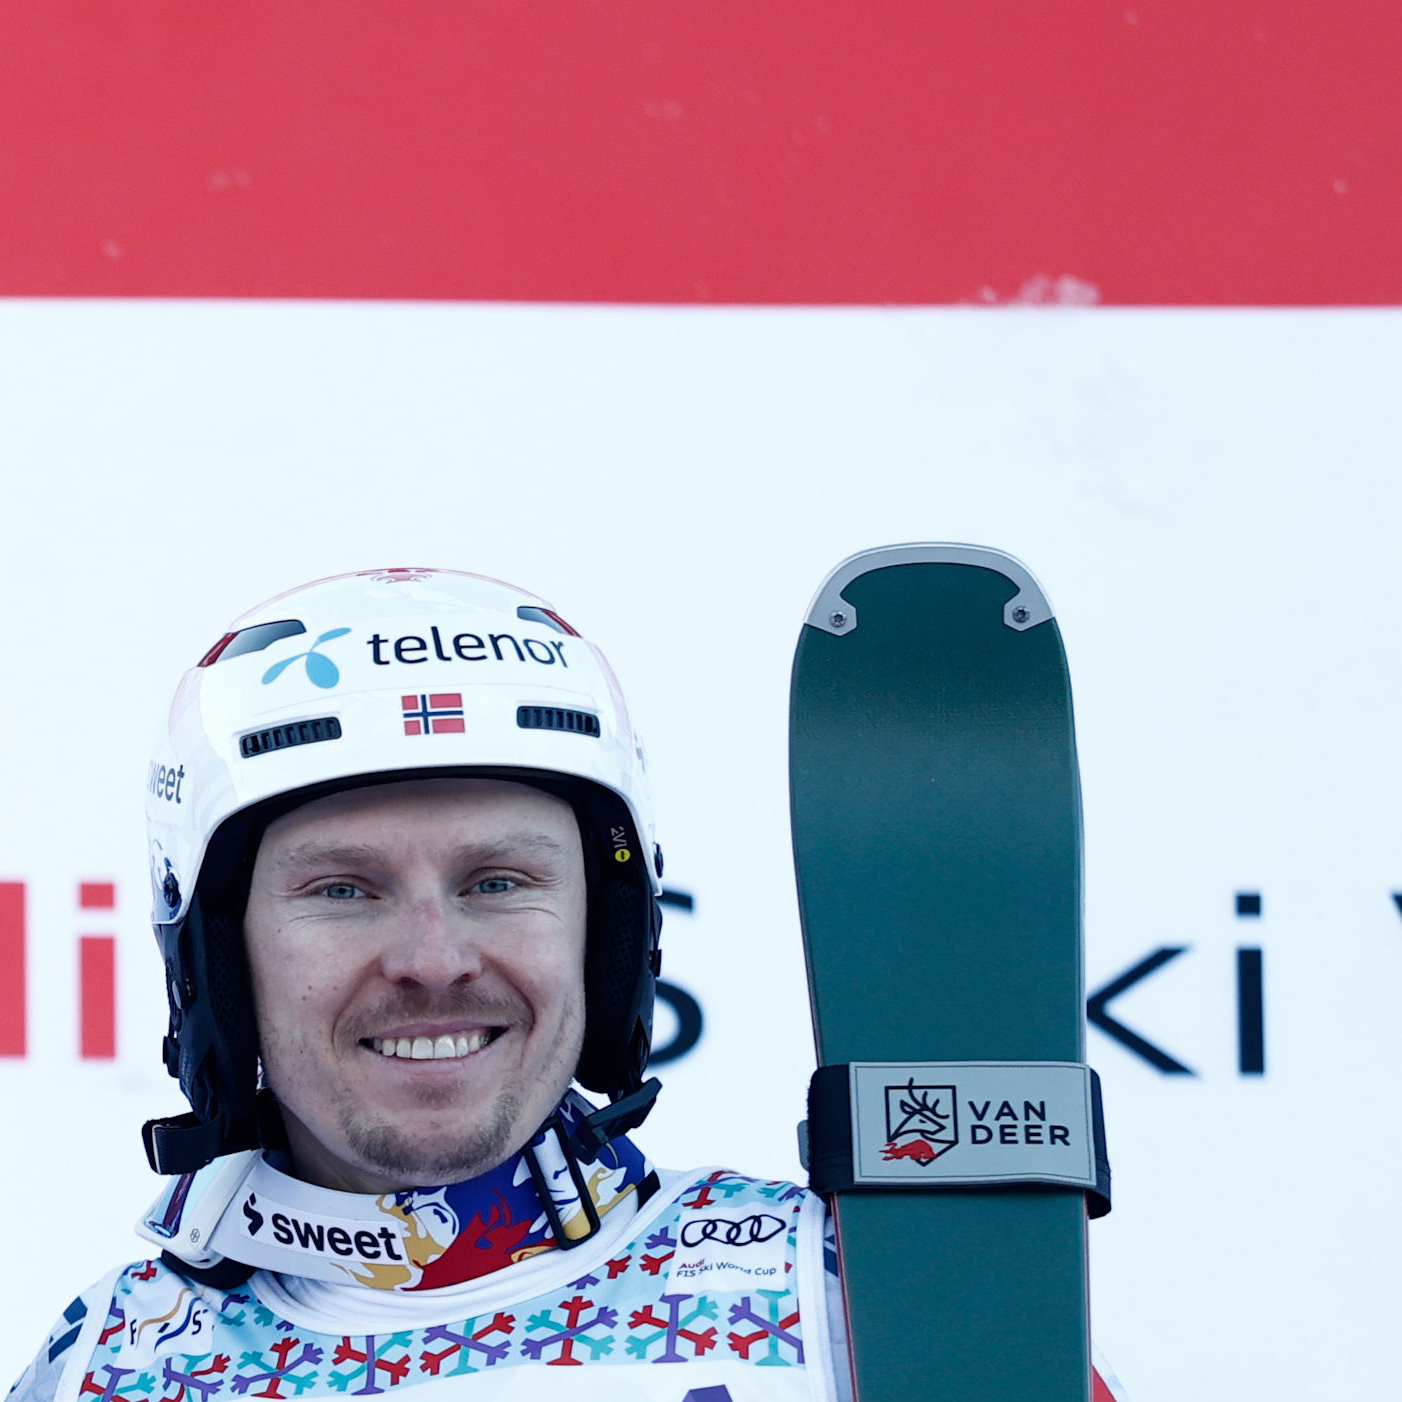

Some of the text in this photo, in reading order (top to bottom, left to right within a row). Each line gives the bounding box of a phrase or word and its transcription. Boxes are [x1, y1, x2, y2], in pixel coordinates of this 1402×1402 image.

[367, 625, 570, 669] telenor
[149, 762, 184, 804] weet
[1085, 890, 1267, 1078] ki
[967, 1100, 1047, 1122] VAN
[970, 1123, 1070, 1147] DEER
[272, 1212, 401, 1263] sweet
[677, 1269, 696, 1277] FIS
[755, 1267, 777, 1276] Cup
[679, 1259, 705, 1269] Audi
